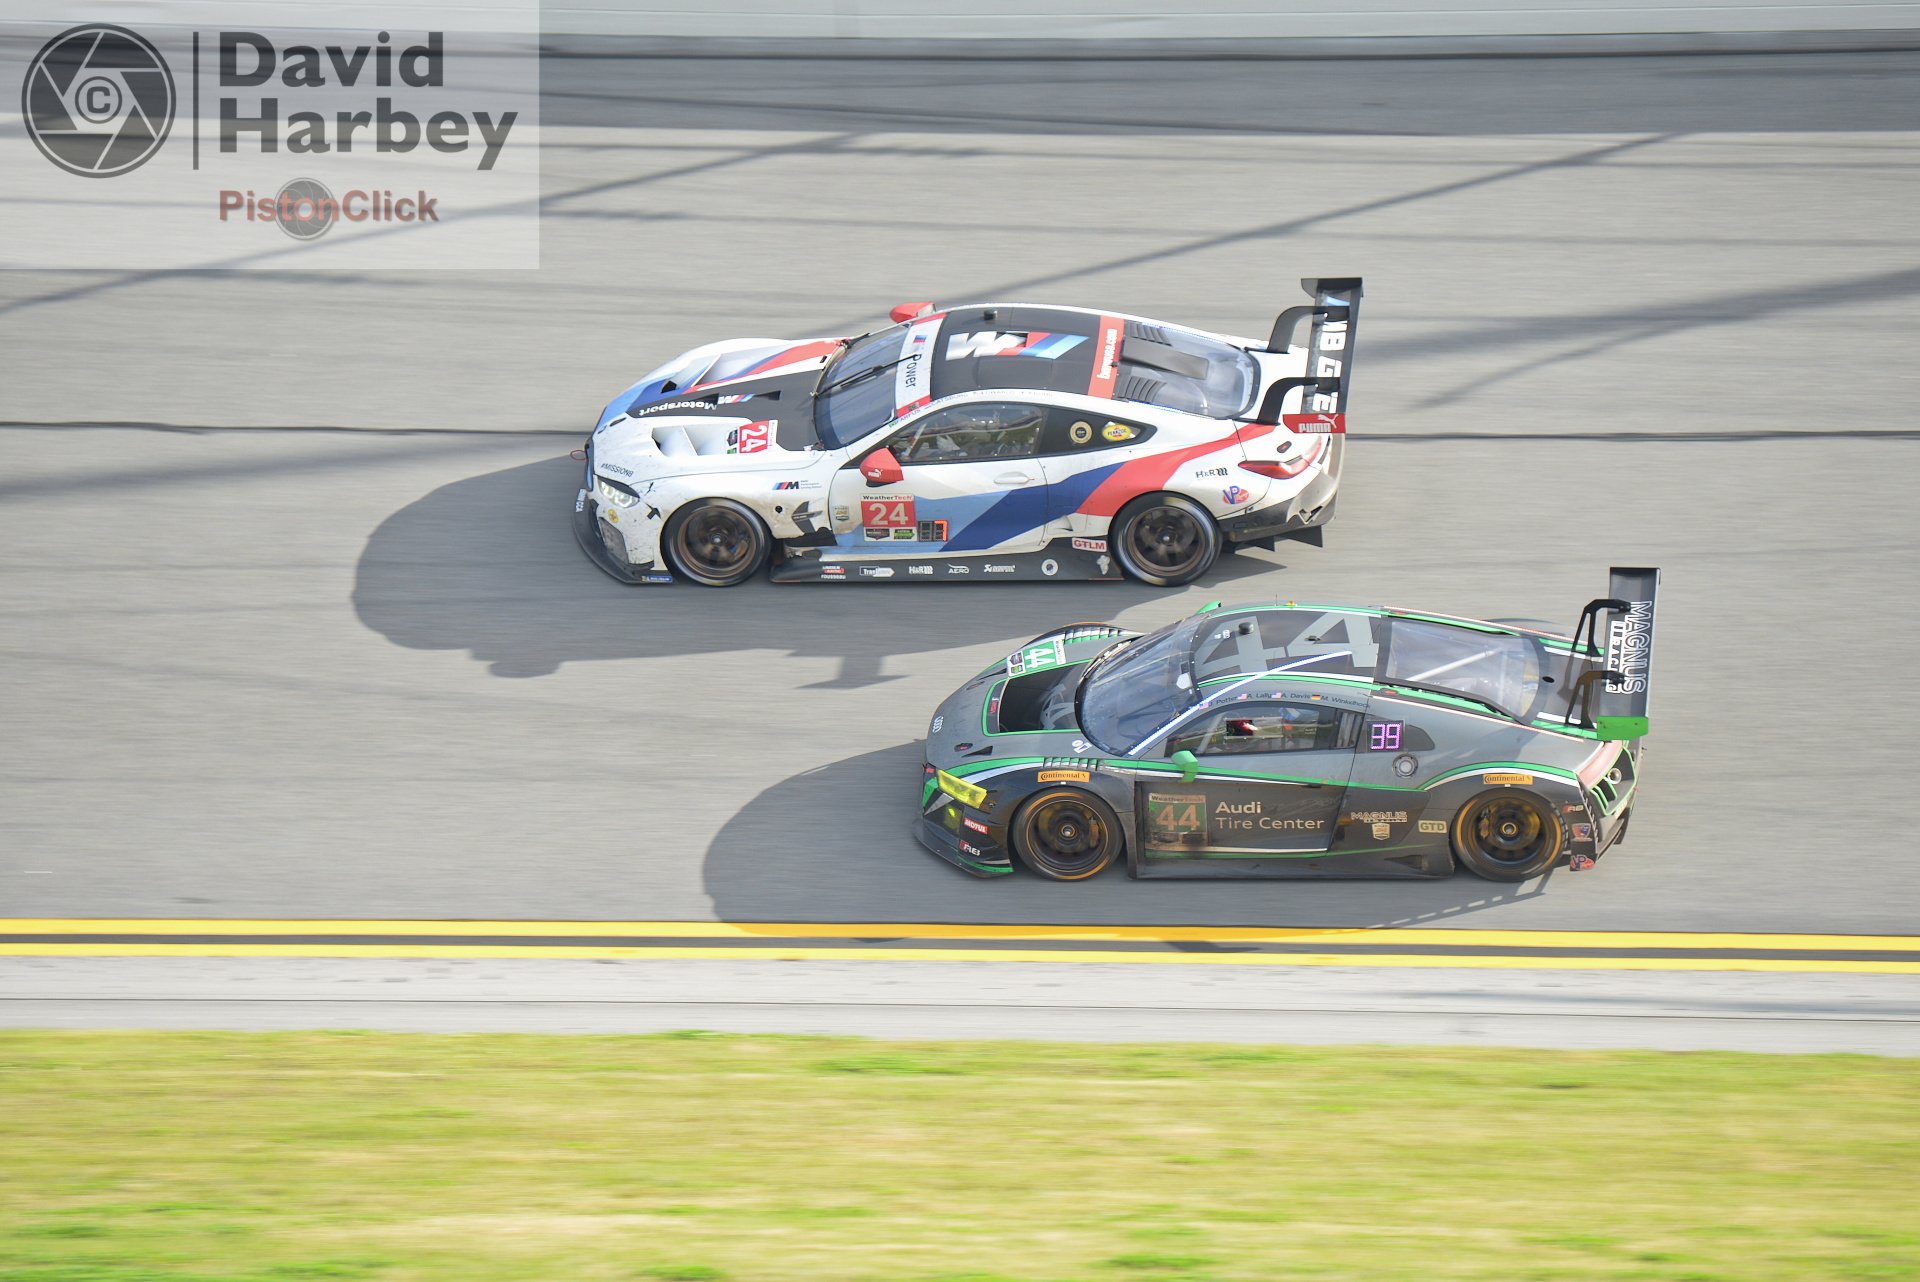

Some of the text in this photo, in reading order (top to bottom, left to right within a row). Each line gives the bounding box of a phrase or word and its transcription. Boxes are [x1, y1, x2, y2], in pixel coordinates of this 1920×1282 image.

[906, 353, 922, 388] Power
[638, 401, 718, 416] Motorsport
[1298, 422, 1332, 433] PUMA
[741, 424, 768, 453] 24
[1222, 485, 1241, 505] VP
[868, 502, 909, 526] 24
[1073, 540, 1106, 550] GTLM
[1623, 600, 1653, 695] MAGNUS
[1024, 648, 1056, 669] 44
[1370, 723, 1401, 750] 39
[1040, 772, 1080, 780] Continental
[1484, 775, 1525, 783] Continental
[1215, 801, 1262, 814] Audi
[1155, 804, 1200, 831] 44
[1215, 817, 1325, 829] Tire Center
[964, 819, 987, 833] MOTUL
[1420, 822, 1445, 831] GTD
